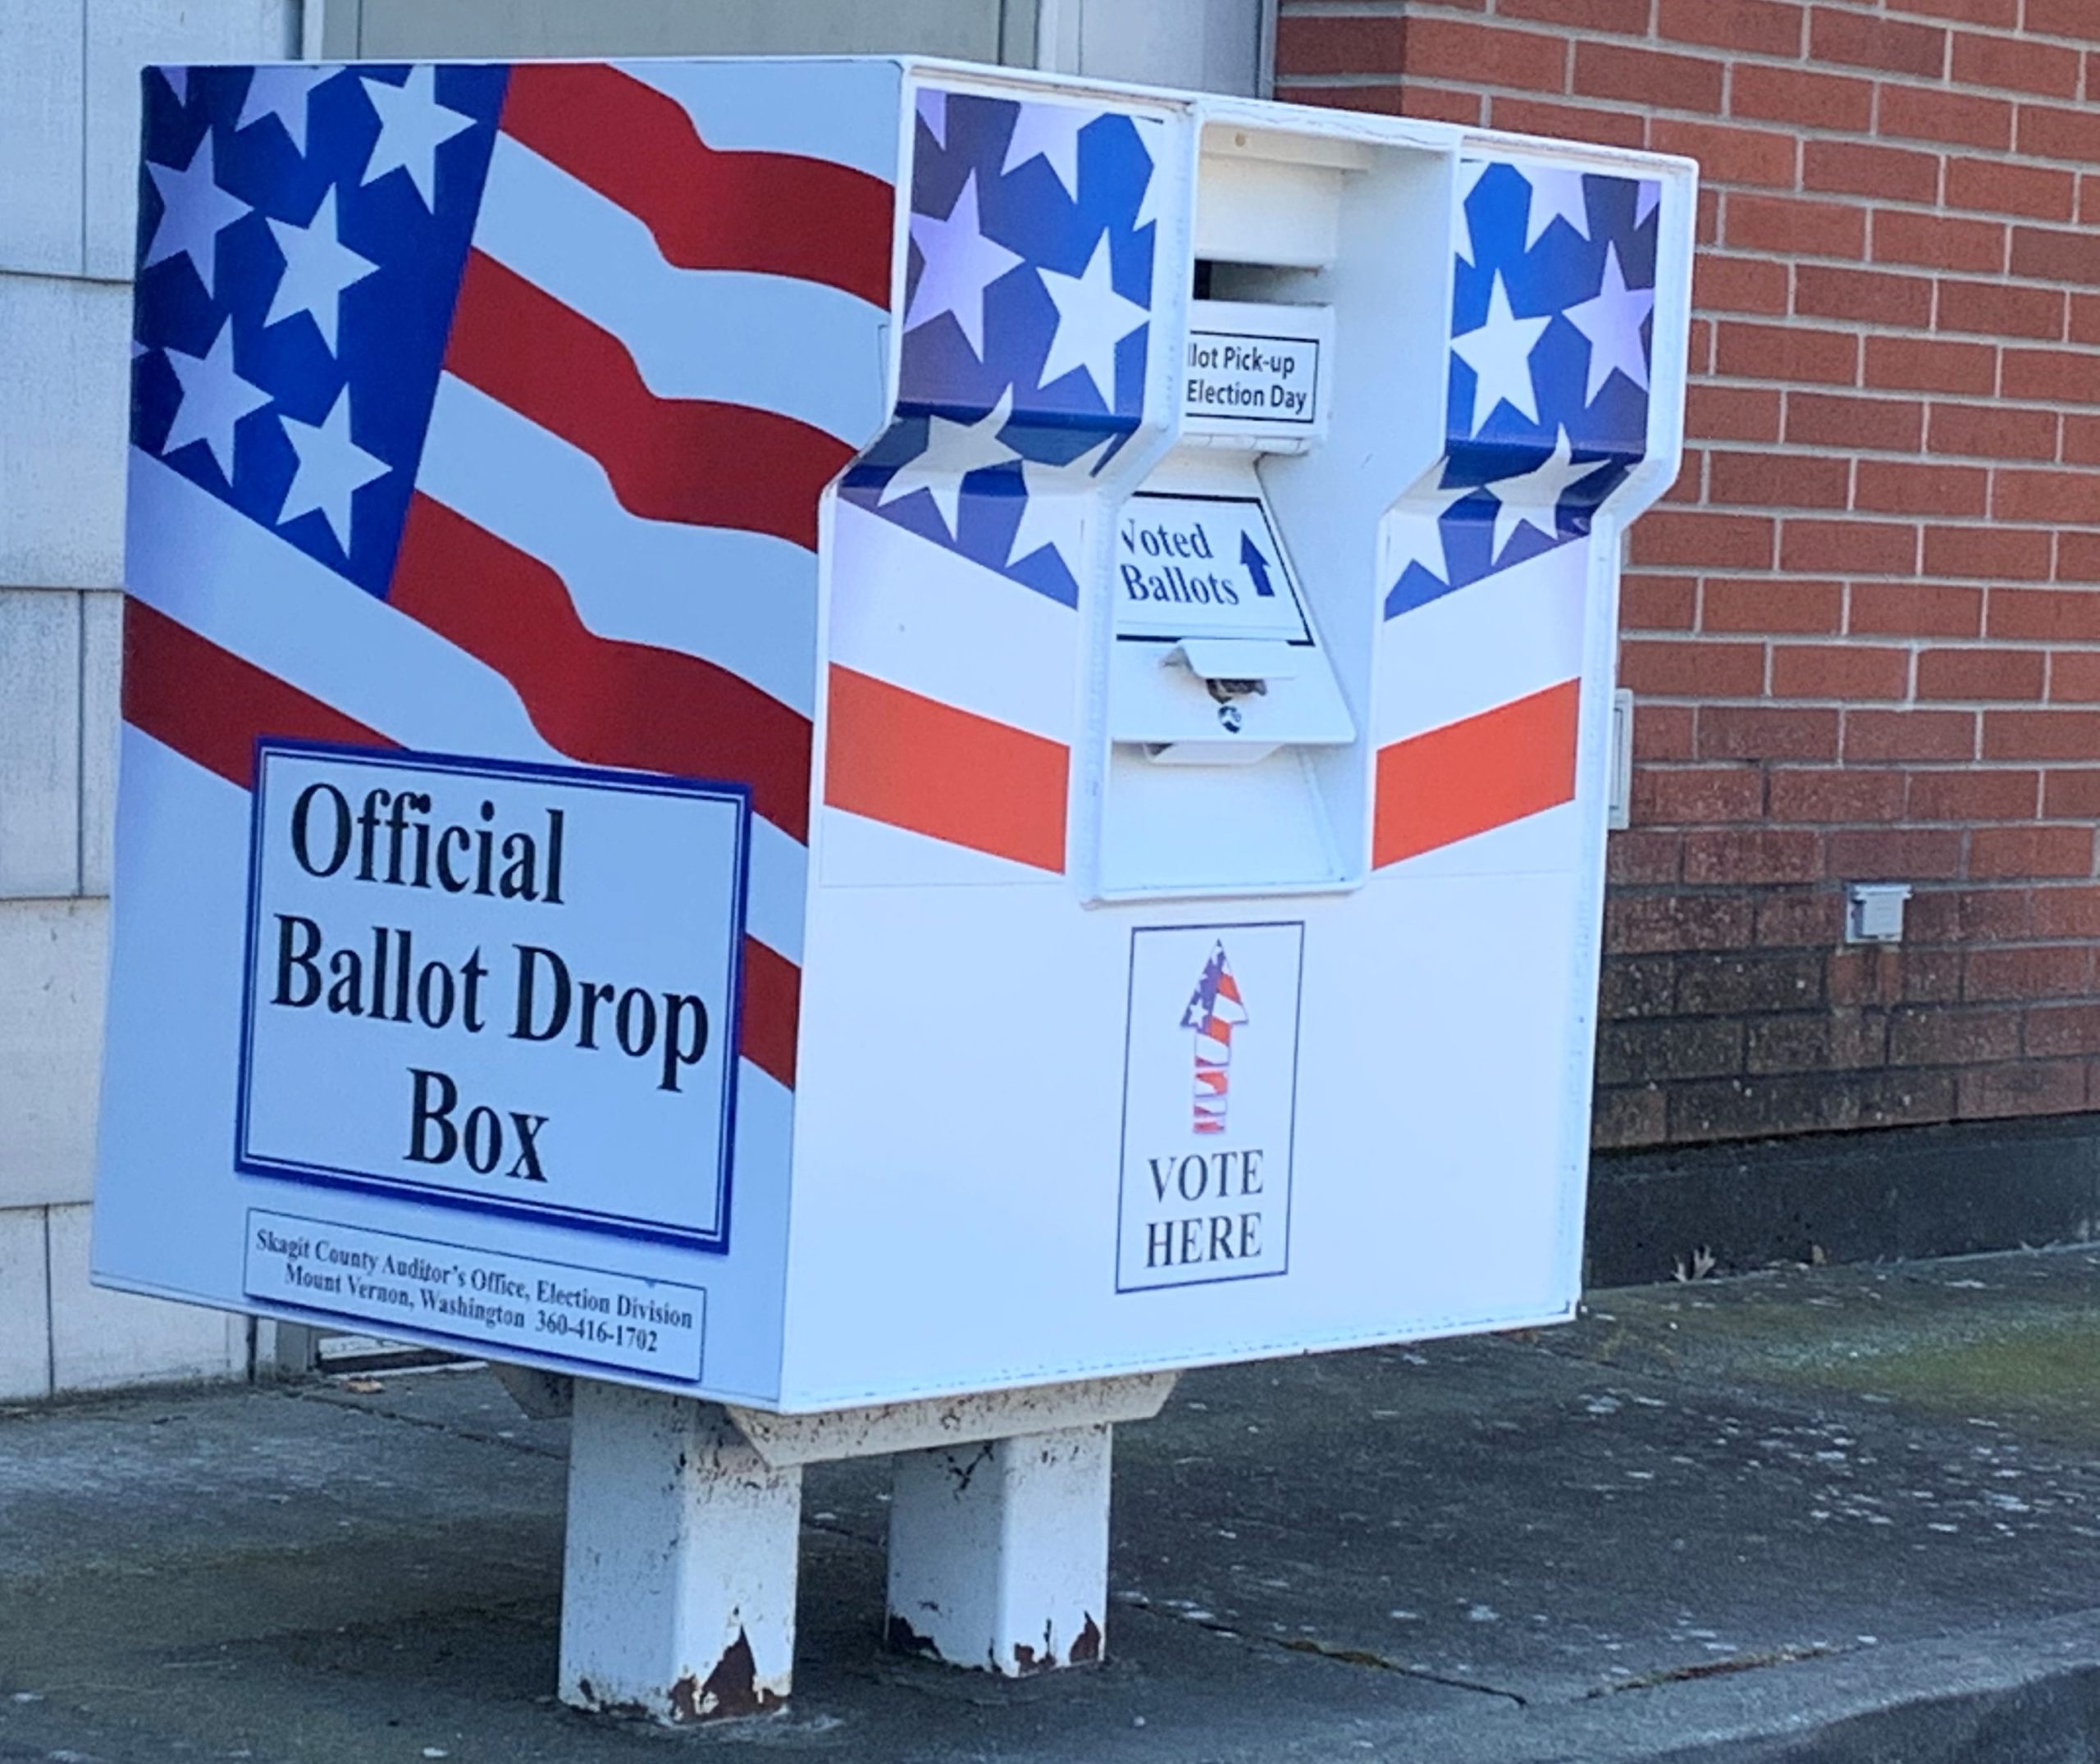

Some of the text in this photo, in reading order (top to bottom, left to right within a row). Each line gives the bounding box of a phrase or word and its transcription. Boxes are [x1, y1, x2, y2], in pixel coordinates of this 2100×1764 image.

[1223, 346, 1295, 380] Pick-up
[1187, 378, 1308, 415] Election Day
[1121, 518, 1214, 559] Voted
[1120, 563, 1239, 605] Ballots
[291, 782, 564, 905] Official
[270, 913, 710, 1093] Ballot Drop
[402, 1067, 550, 1183] Box
[1147, 1149, 1264, 1204] VOTE
[1143, 1211, 1262, 1269] HERE
[256, 1228, 692, 1329] Skagit County Auditor's Office, Election Division
[285, 1263, 658, 1352] Mount Vernon, Washington 360-416-1702
